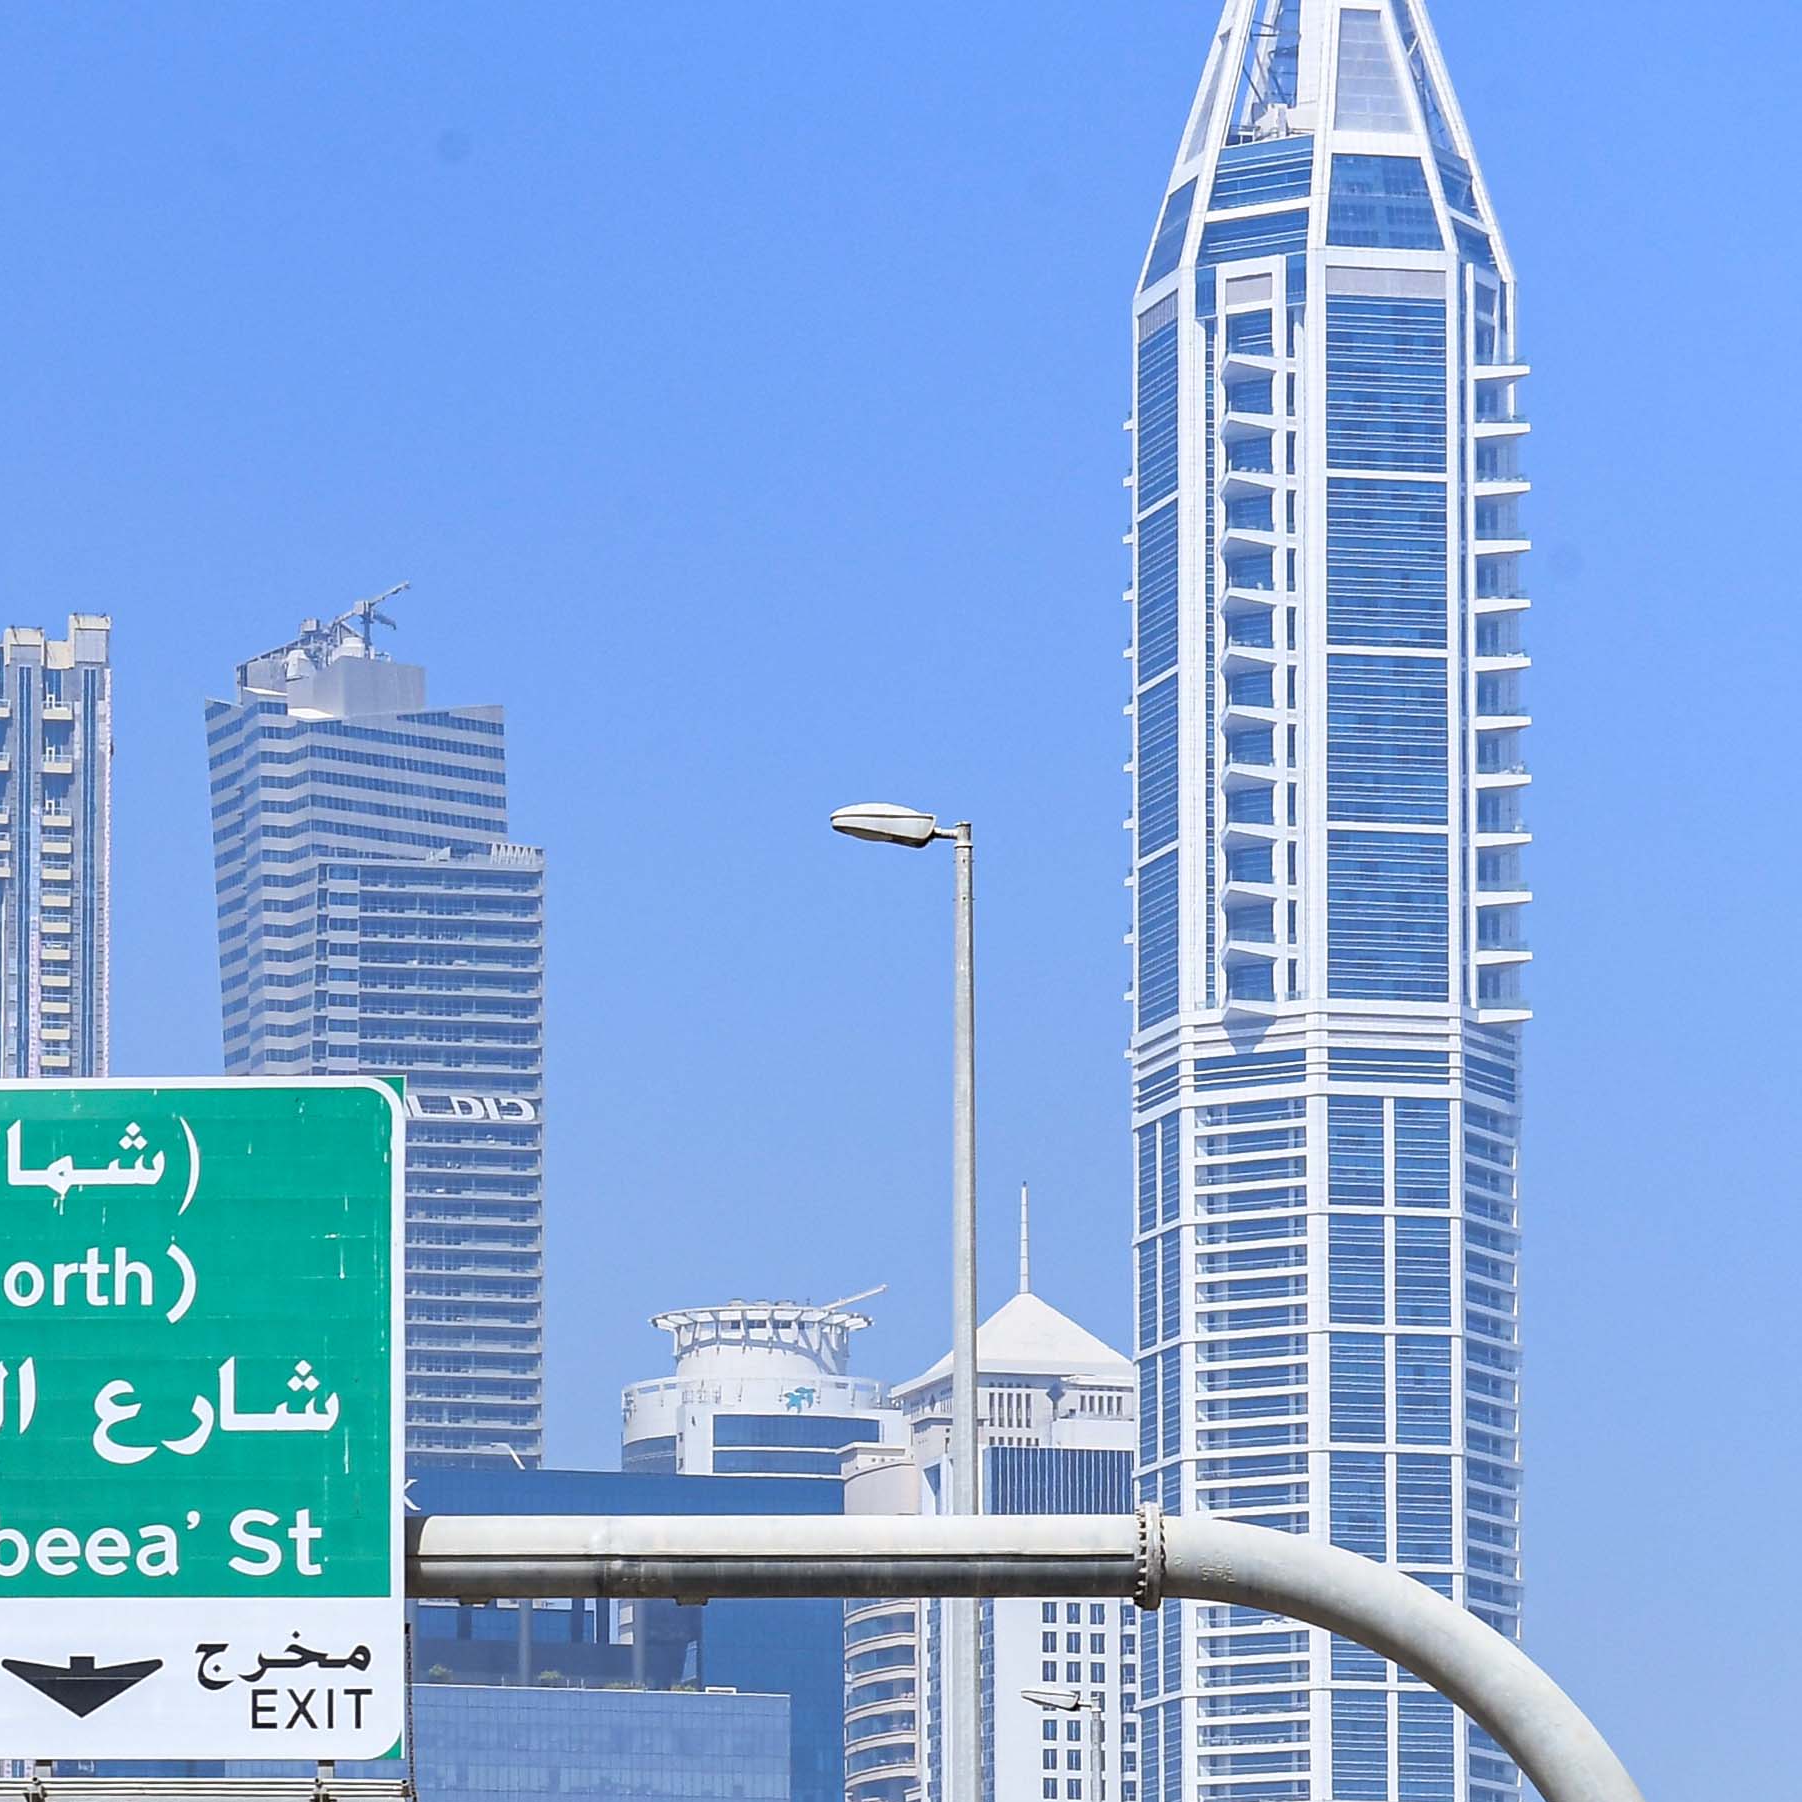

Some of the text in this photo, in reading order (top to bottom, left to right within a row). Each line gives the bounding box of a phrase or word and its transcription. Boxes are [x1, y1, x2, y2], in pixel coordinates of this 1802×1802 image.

[93, 1357, 339, 1464] شارع
[228, 1509, 322, 1576] St
[196, 1631, 372, 1689] مخرج
[251, 1688, 373, 1729] EXIT
